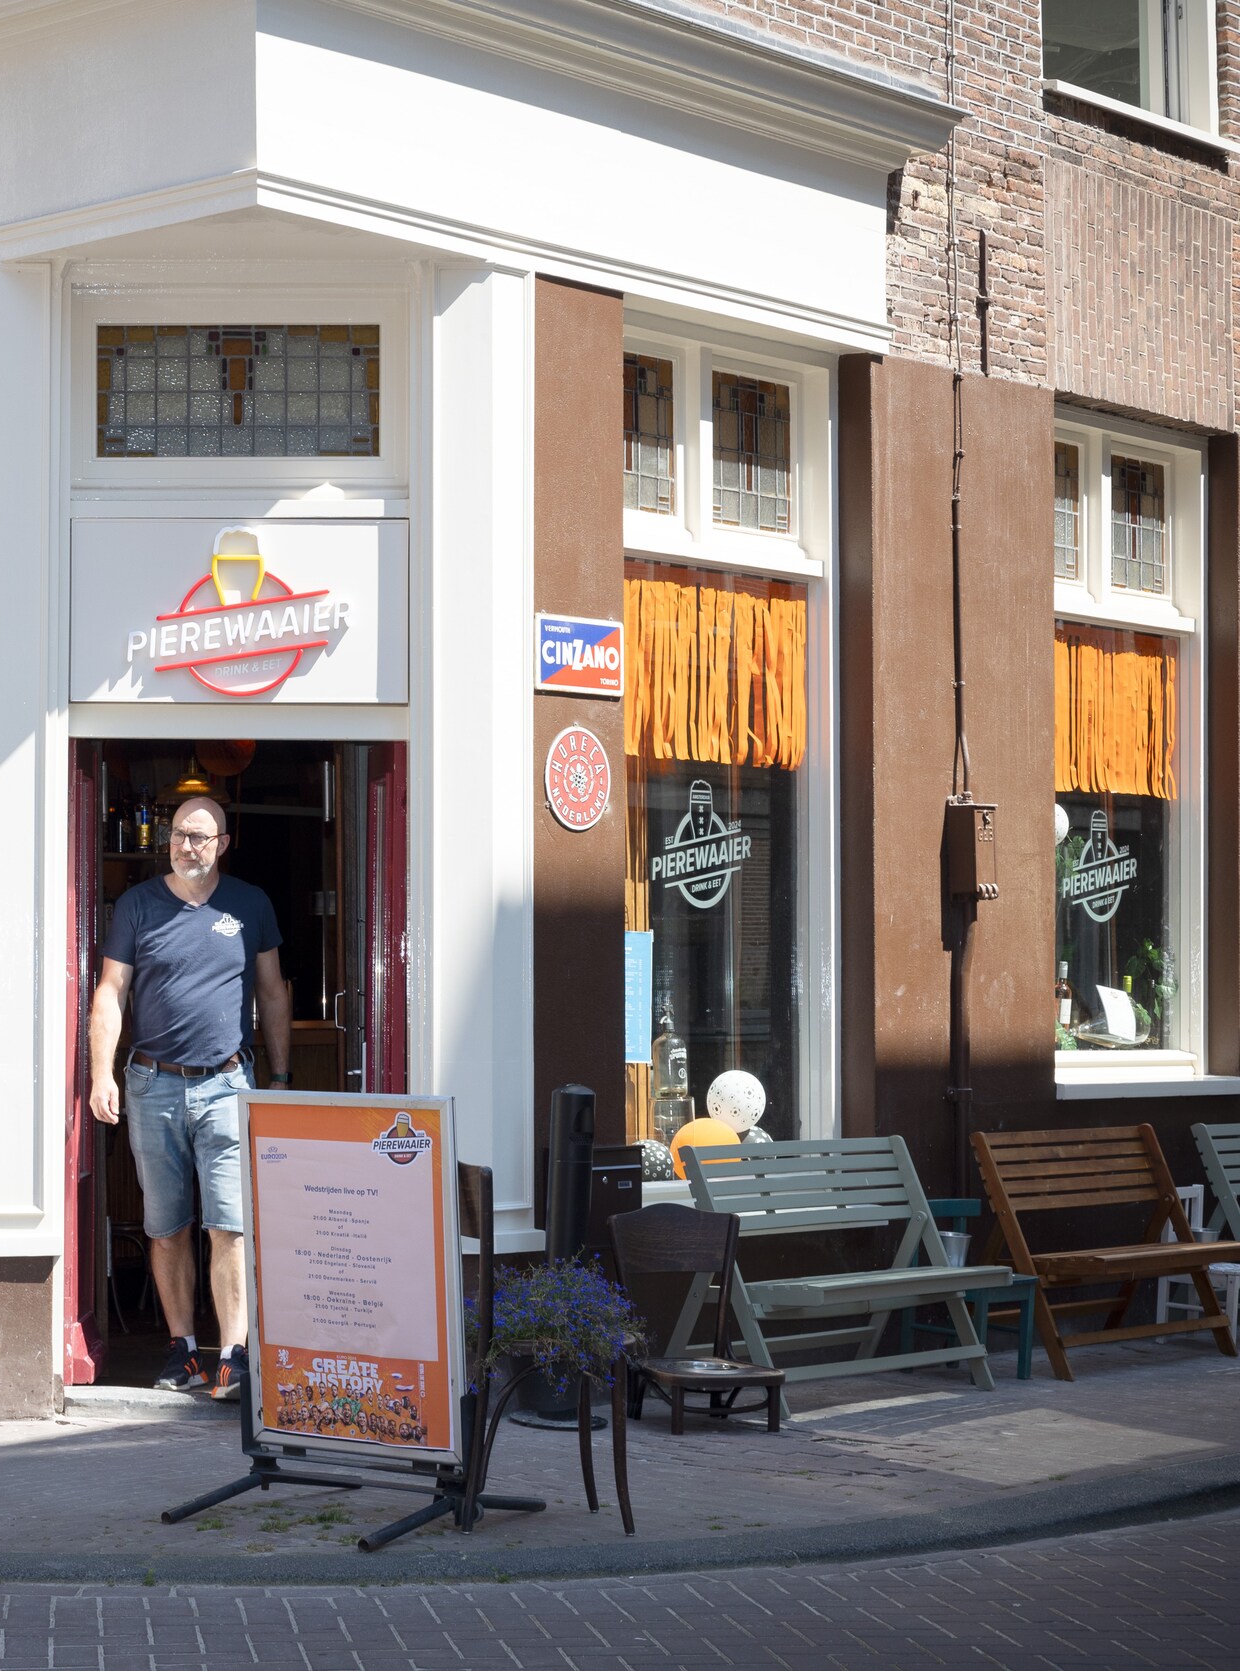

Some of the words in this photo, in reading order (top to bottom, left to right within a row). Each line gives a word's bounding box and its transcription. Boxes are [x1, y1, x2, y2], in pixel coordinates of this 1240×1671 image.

[127, 601, 353, 662] PIEREWAAIER
[544, 624, 571, 633] VERMOUTH
[542, 638, 620, 670] CINZANO
[215, 662, 250, 677] DRINK
[251, 661, 259, 673] &
[262, 657, 282, 671] EET
[599, 677, 619, 686] TORINO
[551, 735, 605, 775] HORECA
[552, 786, 605, 823] NEDERLAND
[728, 820, 742, 831] 2024
[665, 836, 675, 845] EST
[651, 835, 752, 881] PIEREWAAIER
[691, 881, 708, 893] DRINK
[712, 878, 722, 889] EET
[1062, 858, 1138, 899] PIEREWAAIER
[373, 1139, 431, 1150] PIEREWAAIER
[304, 1184, 342, 1194] Wedstrijden
[343, 1187, 355, 1195] live
[356, 1189, 365, 1197] op
[367, 1188, 379, 1197] TV!
[294, 1249, 312, 1257] 18:00
[317, 1251, 350, 1260] Nederland
[356, 1254, 392, 1264] Oostenrijk
[303, 1294, 320, 1302] 18:00
[362, 1299, 384, 1308] België
[312, 1357, 379, 1379] CREATE
[304, 1372, 383, 1394] HISTORY
